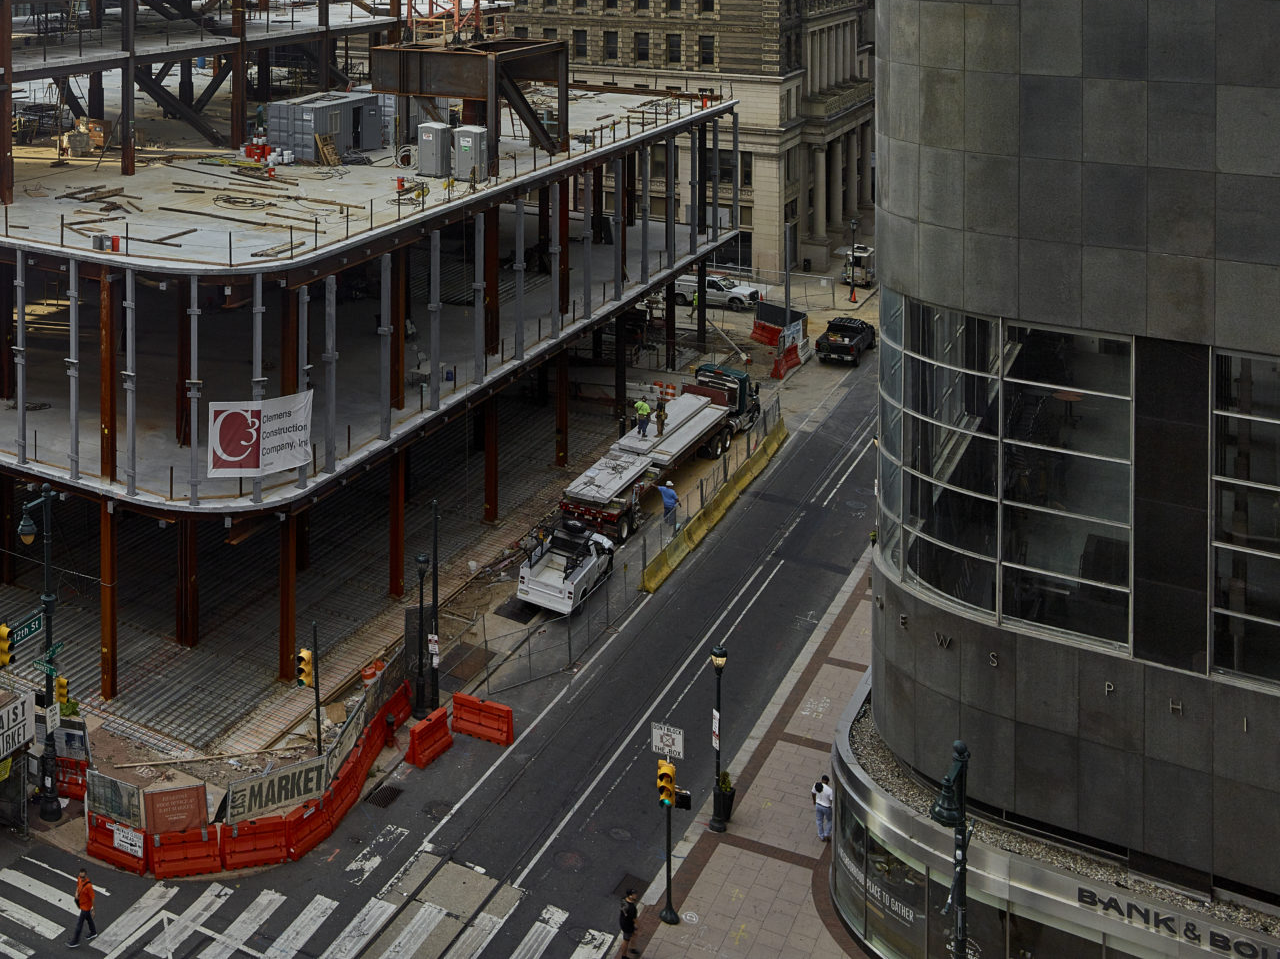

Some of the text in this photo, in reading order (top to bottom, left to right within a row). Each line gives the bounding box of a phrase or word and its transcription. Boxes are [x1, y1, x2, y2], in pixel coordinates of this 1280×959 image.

[262, 410, 292, 424] Clemens
[262, 423, 308, 440] Construction
[262, 442, 296, 456] Company,
[13, 620, 39, 642] 12th St
[49, 705, 57, 714] NO
[666, 728, 682, 736] BLOCK
[654, 744, 682, 757] THE BOX
[230, 788, 247, 818] EAST
[247, 764, 325, 814] MARKET
[866, 878, 881, 900] PLACE
[882, 891, 889, 906] TO
[891, 898, 914, 923] GATHER
[1078, 887, 1178, 935] BANK
[1183, 921, 1201, 943] &
